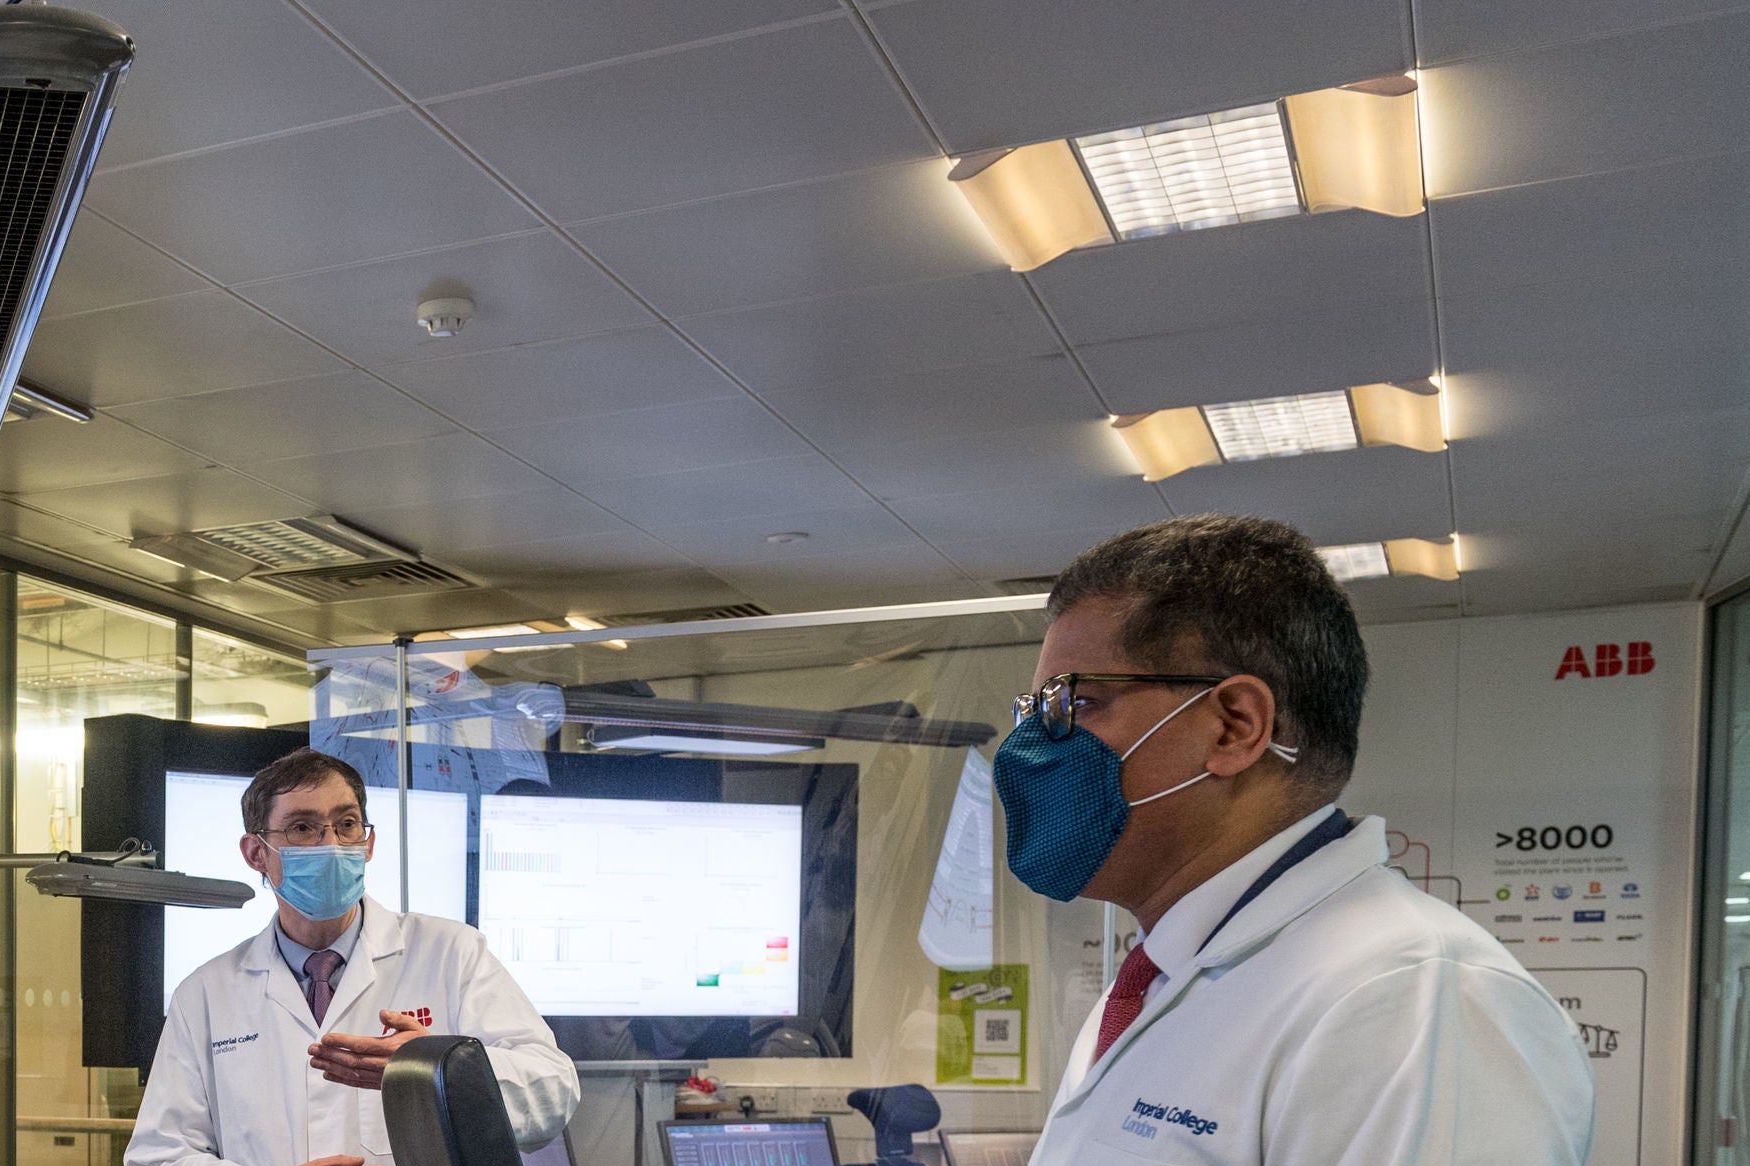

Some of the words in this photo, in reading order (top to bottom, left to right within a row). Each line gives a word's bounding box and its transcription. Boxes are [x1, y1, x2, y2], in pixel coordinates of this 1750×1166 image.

[1555, 641, 1656, 681] ABB
[1496, 824, 1613, 850] >8000
[238, 1032, 259, 1044] College
[1121, 1115, 1158, 1140] London
[1132, 1097, 1169, 1119] Imperial
[1166, 1106, 1218, 1135] College
